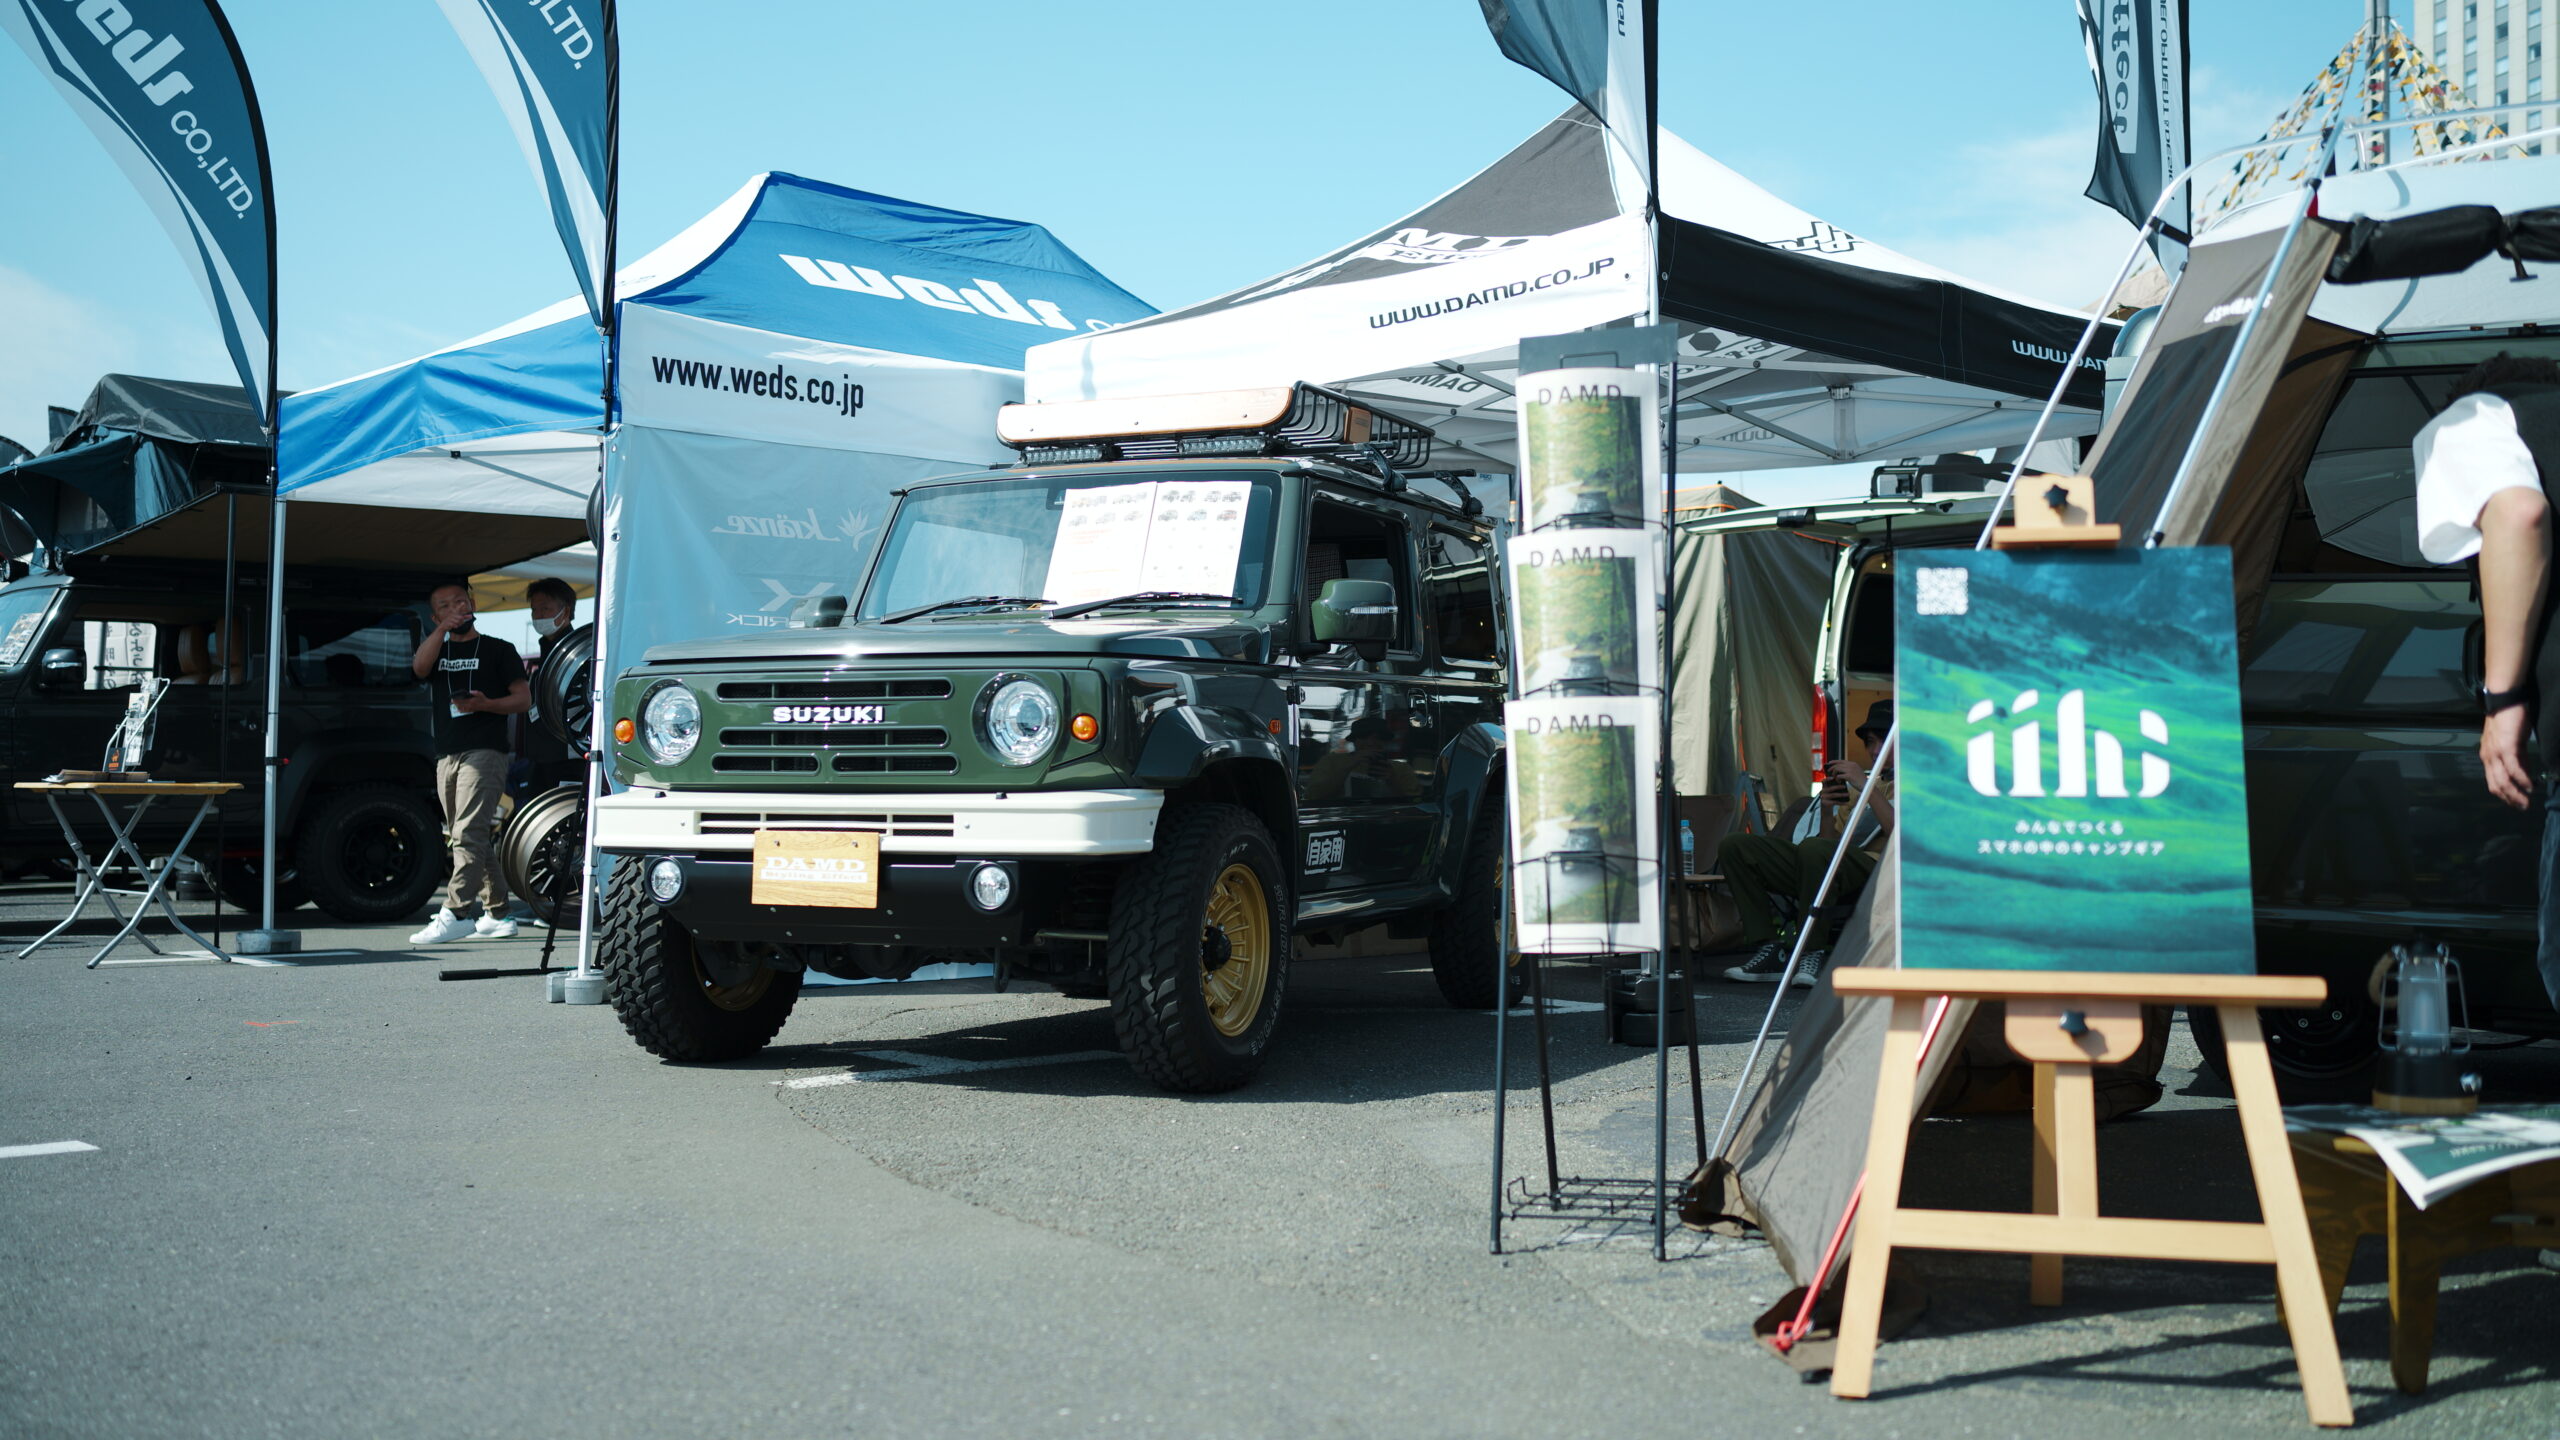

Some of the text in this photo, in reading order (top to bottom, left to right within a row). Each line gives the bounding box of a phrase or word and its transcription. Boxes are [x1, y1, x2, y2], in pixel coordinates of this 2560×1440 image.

[75, 0, 195, 107] eds
[778, 253, 1077, 331] weds
[651, 355, 864, 418] www.weds.co.jp
[1537, 384, 1622, 406] DAMD
[1529, 545, 1615, 569] DAMD
[773, 705, 884, 723] SUZUKI
[1527, 714, 1614, 736] DAMD
[2014, 818, 2125, 837] みんなでつくる
[765, 856, 866, 873] DAMD
